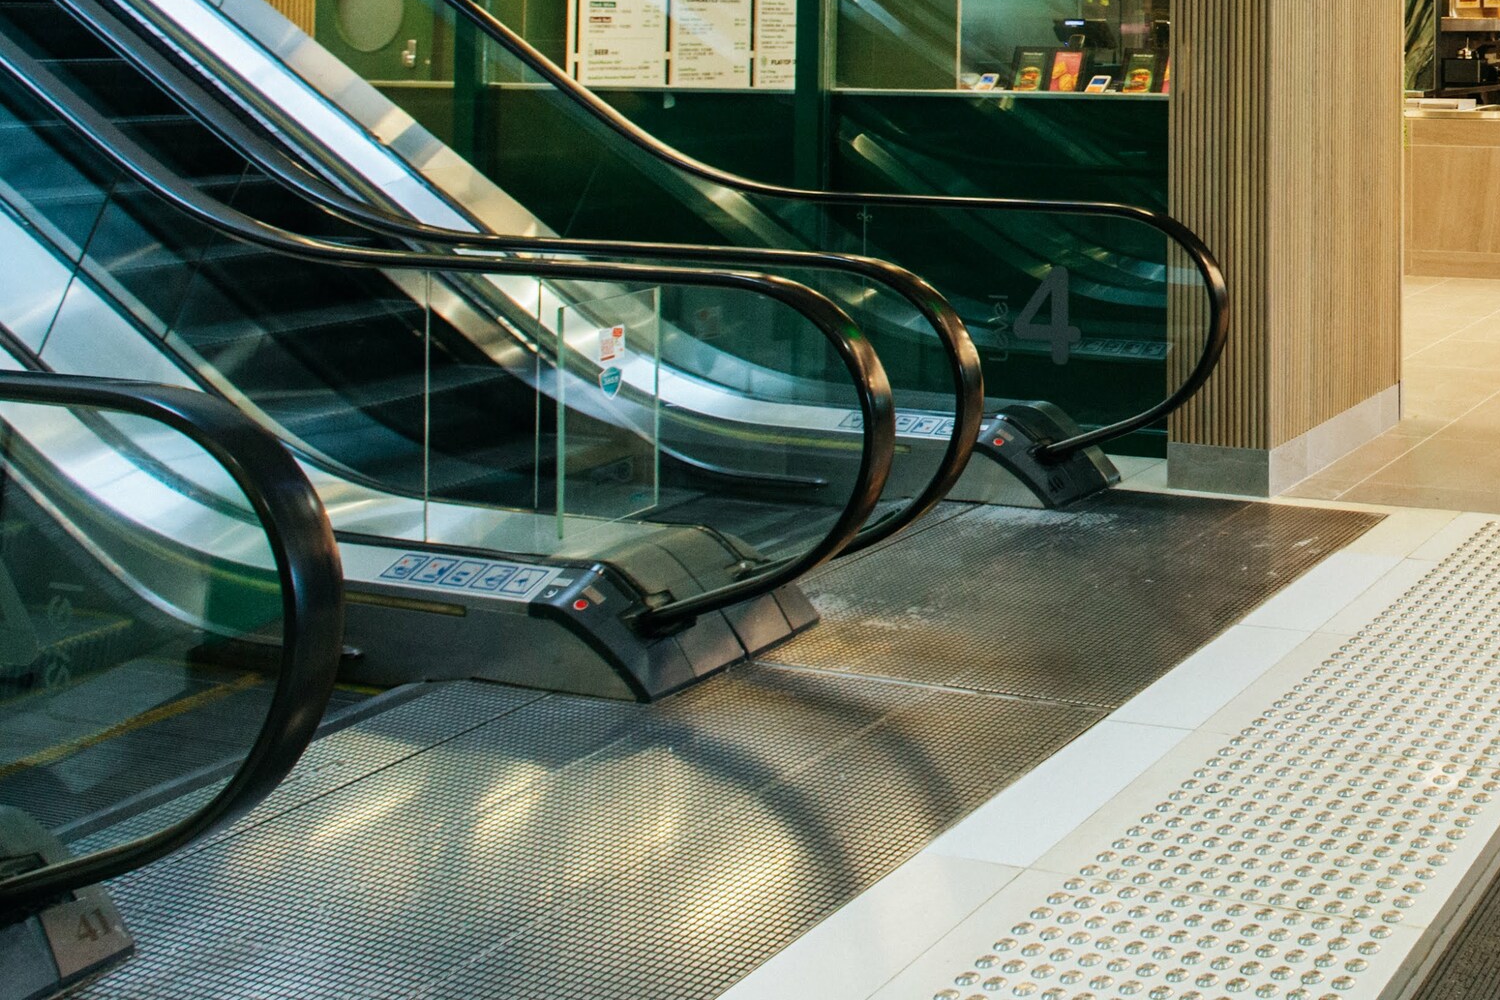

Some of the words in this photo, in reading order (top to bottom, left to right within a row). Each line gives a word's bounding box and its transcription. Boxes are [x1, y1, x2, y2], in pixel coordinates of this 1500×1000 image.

[988, 295, 1009, 361] Level
[1013, 265, 1082, 365] 4
[77, 908, 111, 942] 41
